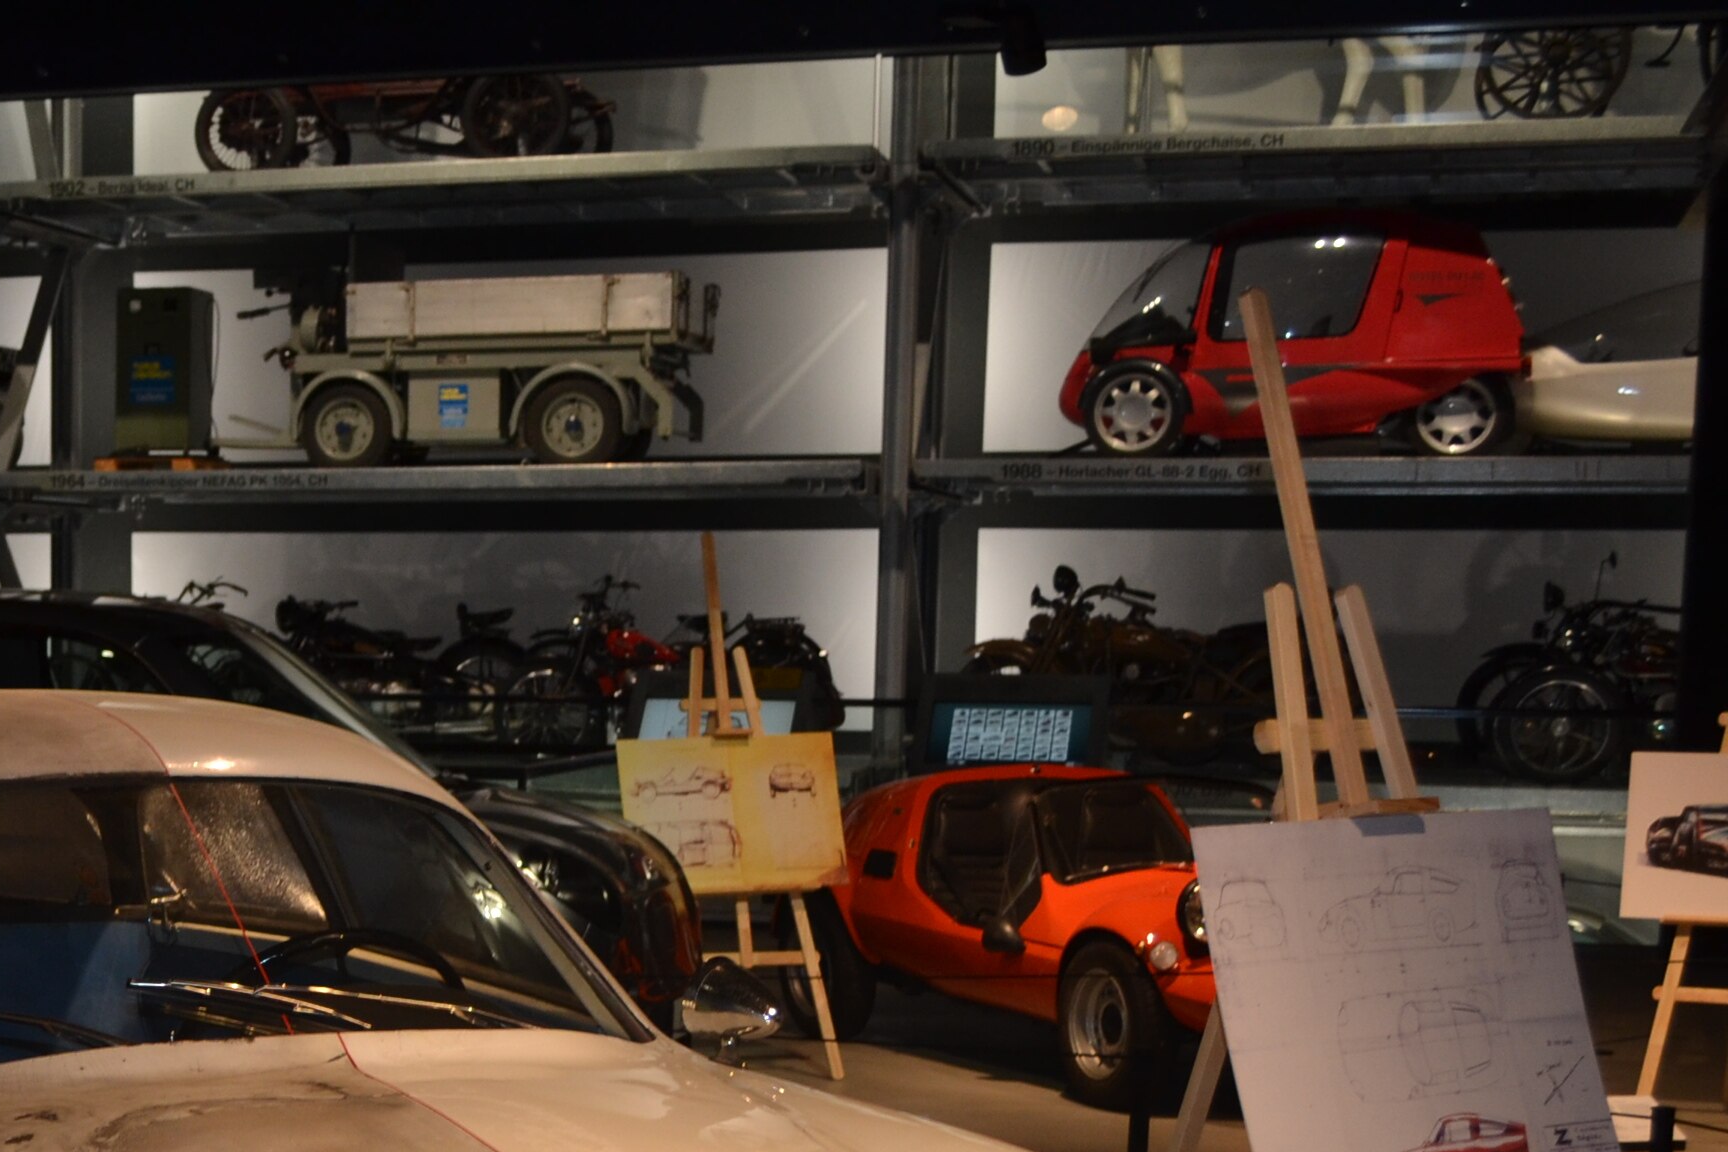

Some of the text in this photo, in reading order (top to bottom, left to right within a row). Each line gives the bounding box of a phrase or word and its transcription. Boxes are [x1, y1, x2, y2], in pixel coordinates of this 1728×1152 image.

[1013, 139, 1055, 156] 1890
[1071, 138, 1162, 154] Einspännige
[1166, 136, 1256, 151] Bergchaise,
[1260, 133, 1285, 147] CH
[50, 180, 85, 197] 1902
[174, 178, 195, 191] CH
[1001, 463, 1042, 478] 1988
[1058, 464, 1130, 478] Horlacher
[1199, 464, 1231, 480] Egg,
[1236, 462, 1261, 477] CH
[51, 474, 85, 488] 1964
[249, 474, 267, 486] PK
[308, 473, 328, 486] CH
